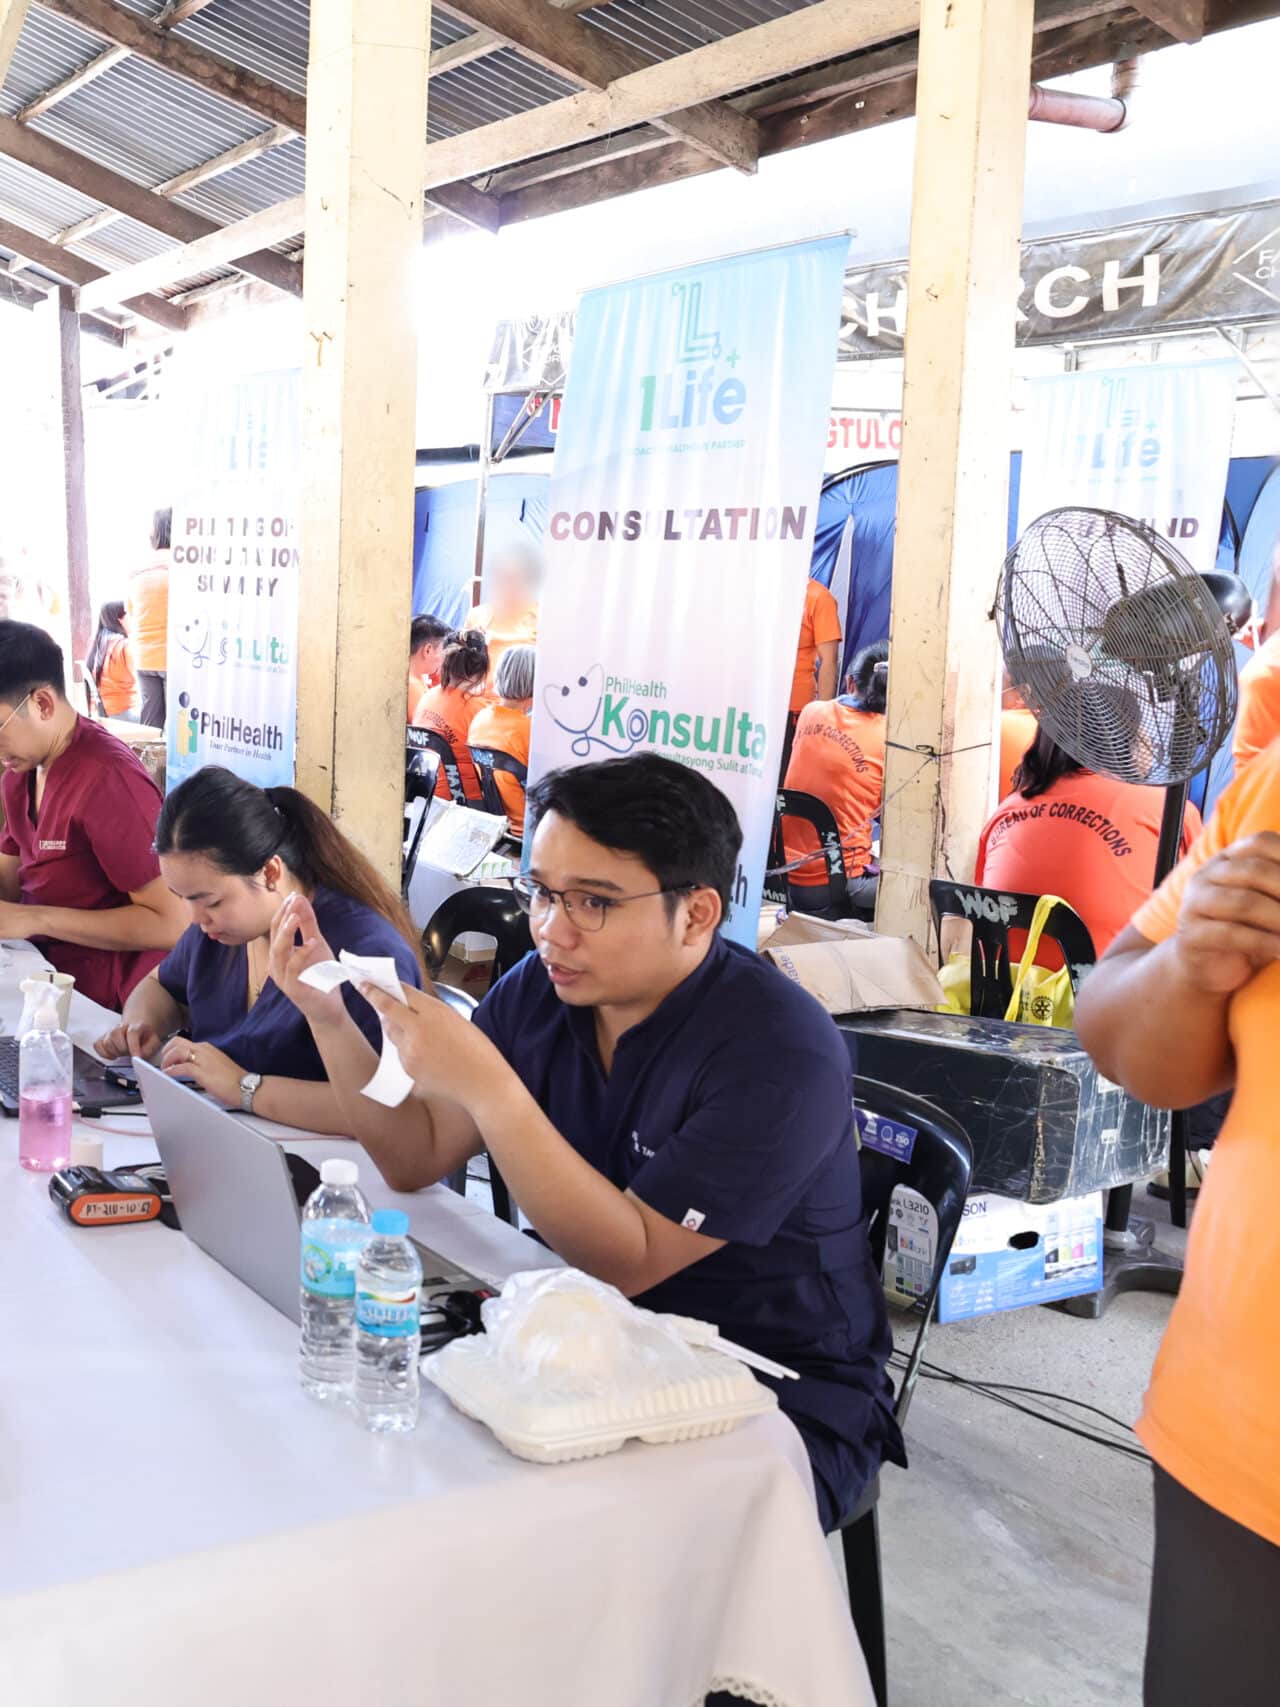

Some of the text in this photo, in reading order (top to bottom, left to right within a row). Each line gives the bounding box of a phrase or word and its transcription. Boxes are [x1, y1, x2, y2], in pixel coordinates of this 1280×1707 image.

[550, 505, 807, 541] CONSULTATION
[605, 676, 667, 699] PhilHealth
[201, 712, 283, 751] PhilHealth
[601, 694, 766, 760] Konsulta
[1030, 803, 1047, 818] OF
[1049, 803, 1132, 857] CORRECTIONS
[903, 1200, 930, 1216] L3210
[962, 1202, 987, 1216] SON
